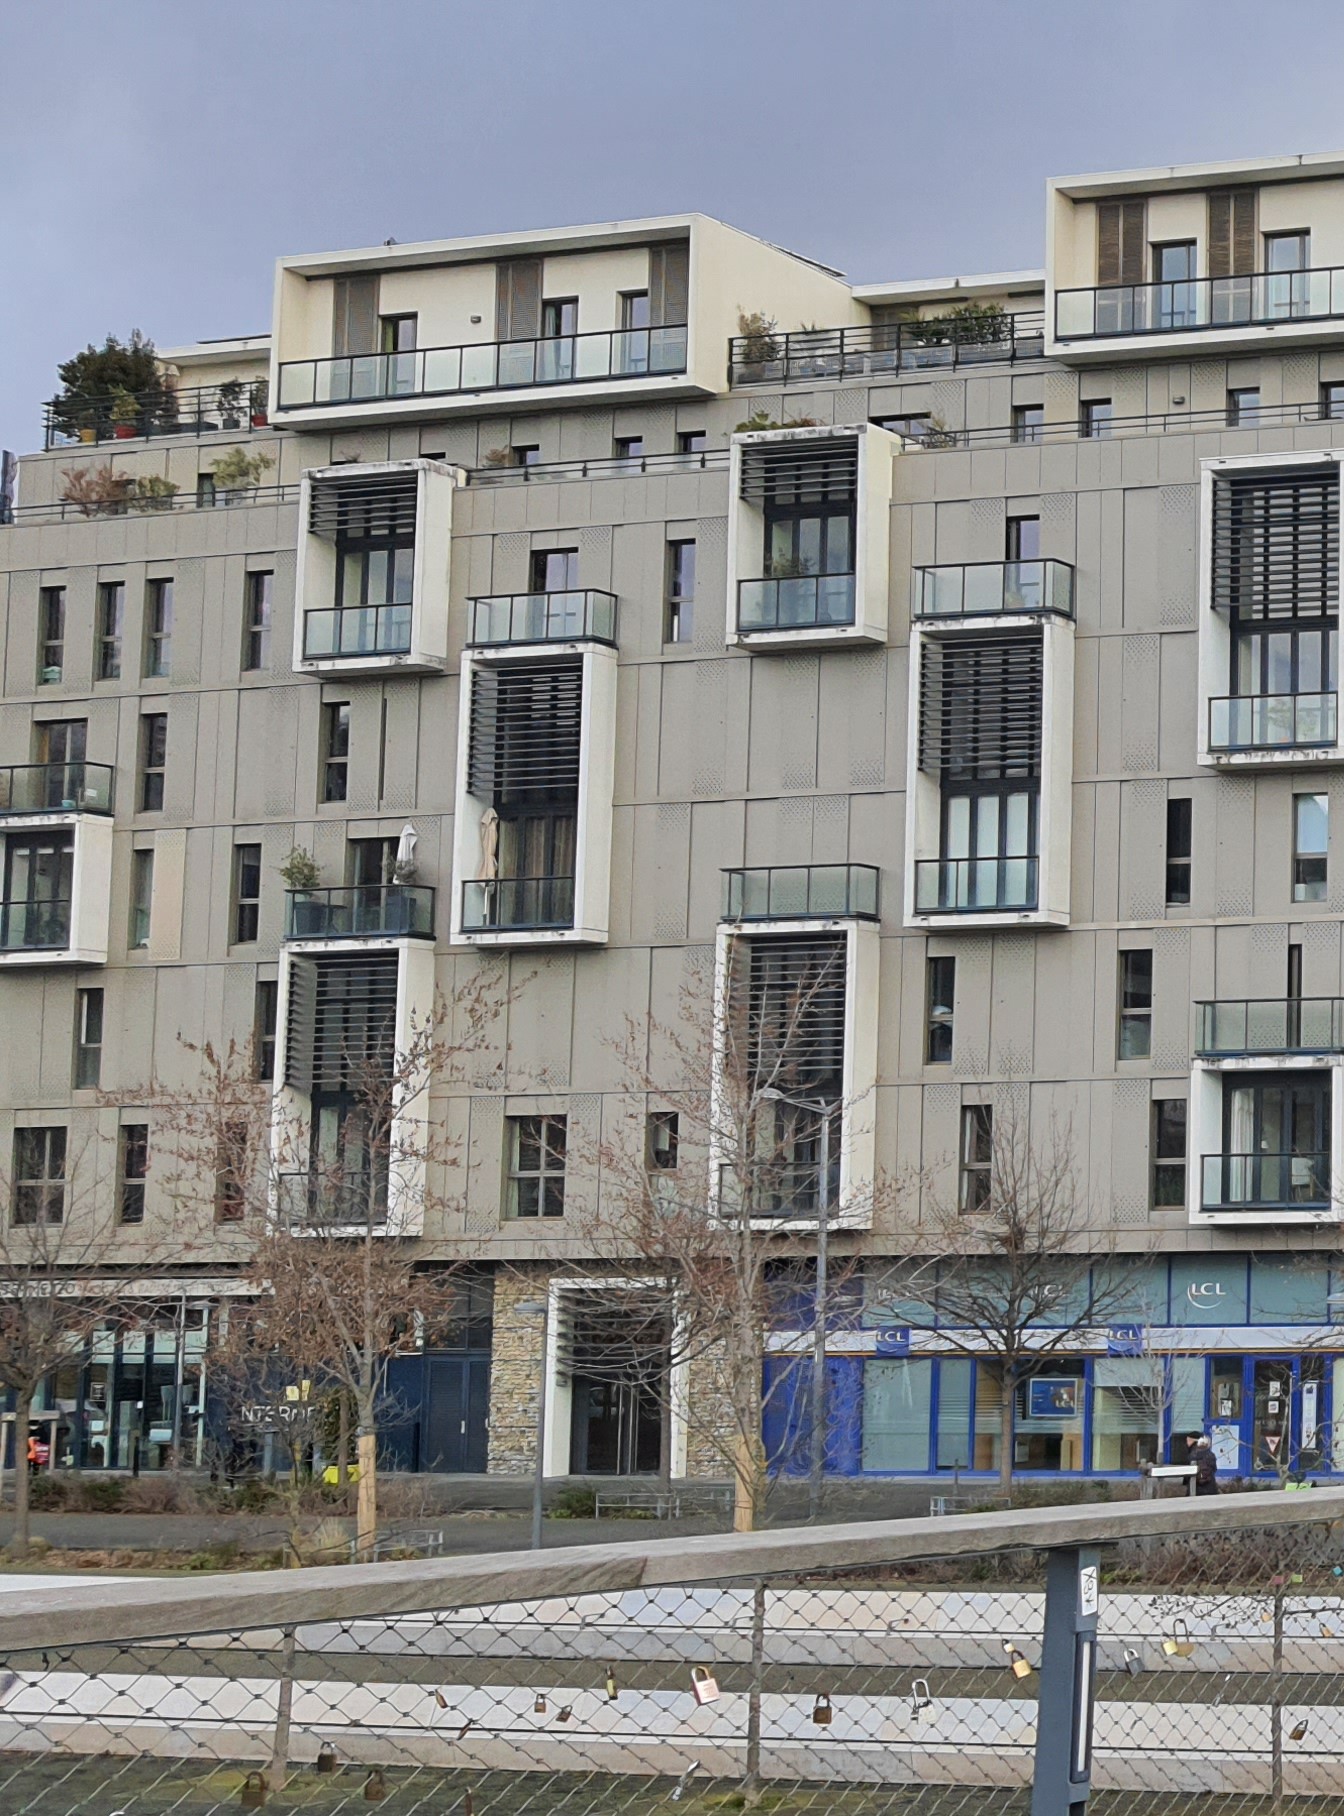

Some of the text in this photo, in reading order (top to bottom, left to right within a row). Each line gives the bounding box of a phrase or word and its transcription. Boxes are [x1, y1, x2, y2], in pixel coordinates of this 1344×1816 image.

[1191, 1282, 1227, 1296] LCL
[877, 1331, 906, 1343] LCL
[1109, 1329, 1138, 1341] LCL
